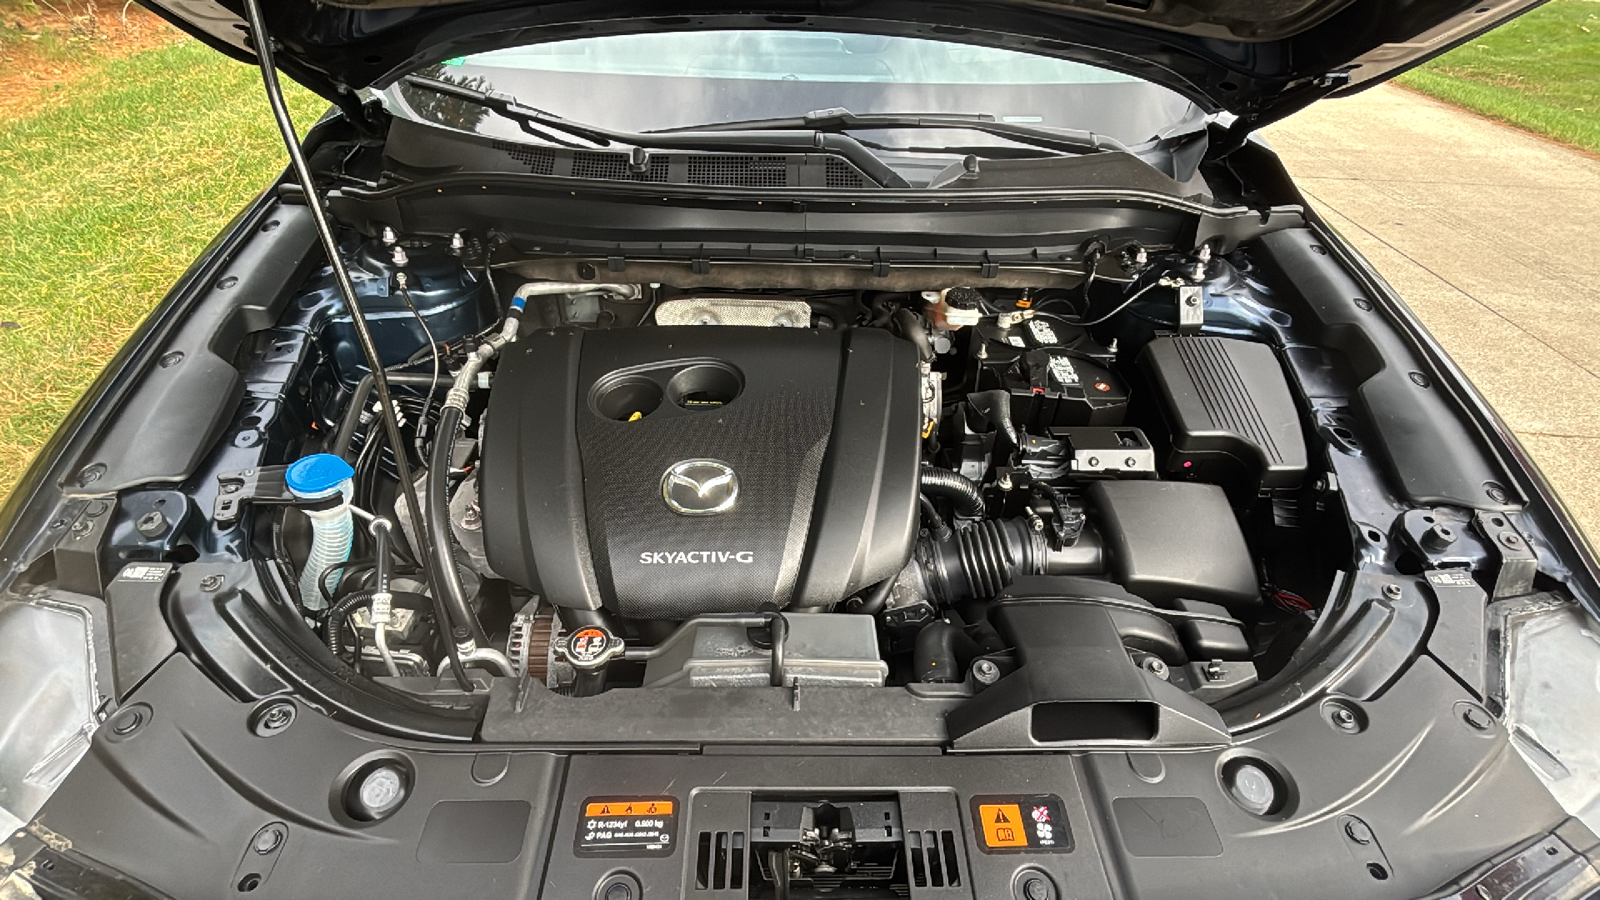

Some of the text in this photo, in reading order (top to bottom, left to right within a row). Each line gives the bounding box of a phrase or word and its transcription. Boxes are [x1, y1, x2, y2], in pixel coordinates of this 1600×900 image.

[639, 551, 754, 564] SKYACTIV-G
[597, 820, 628, 829] R-1234yf
[654, 819, 664, 829] kg
[596, 831, 612, 840] PAG
